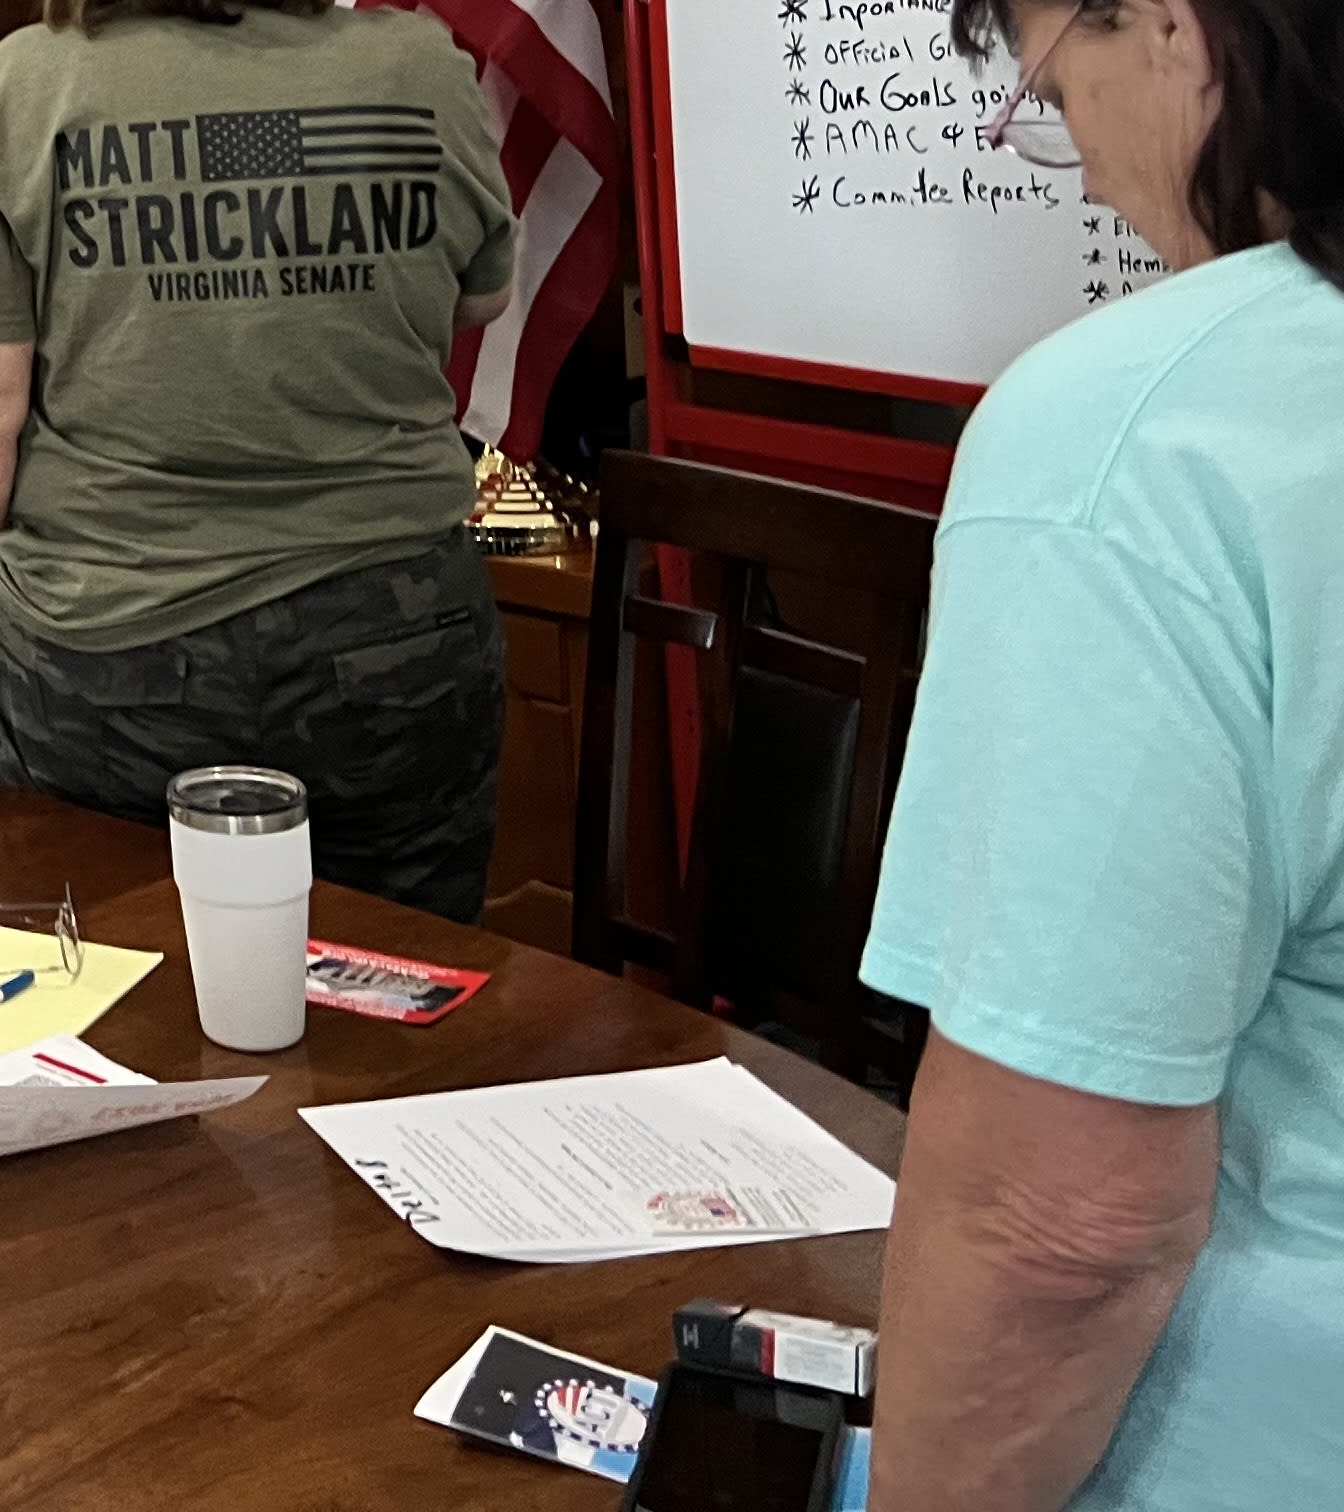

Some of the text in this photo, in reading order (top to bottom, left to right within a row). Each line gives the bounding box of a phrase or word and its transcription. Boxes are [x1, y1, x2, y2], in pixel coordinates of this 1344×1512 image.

[54, 119, 195, 189] MATT
[825, 120, 928, 155] AMAC
[63, 180, 438, 270] STRICKLAND
[147, 263, 377, 302] VIRGINIA SENATE
